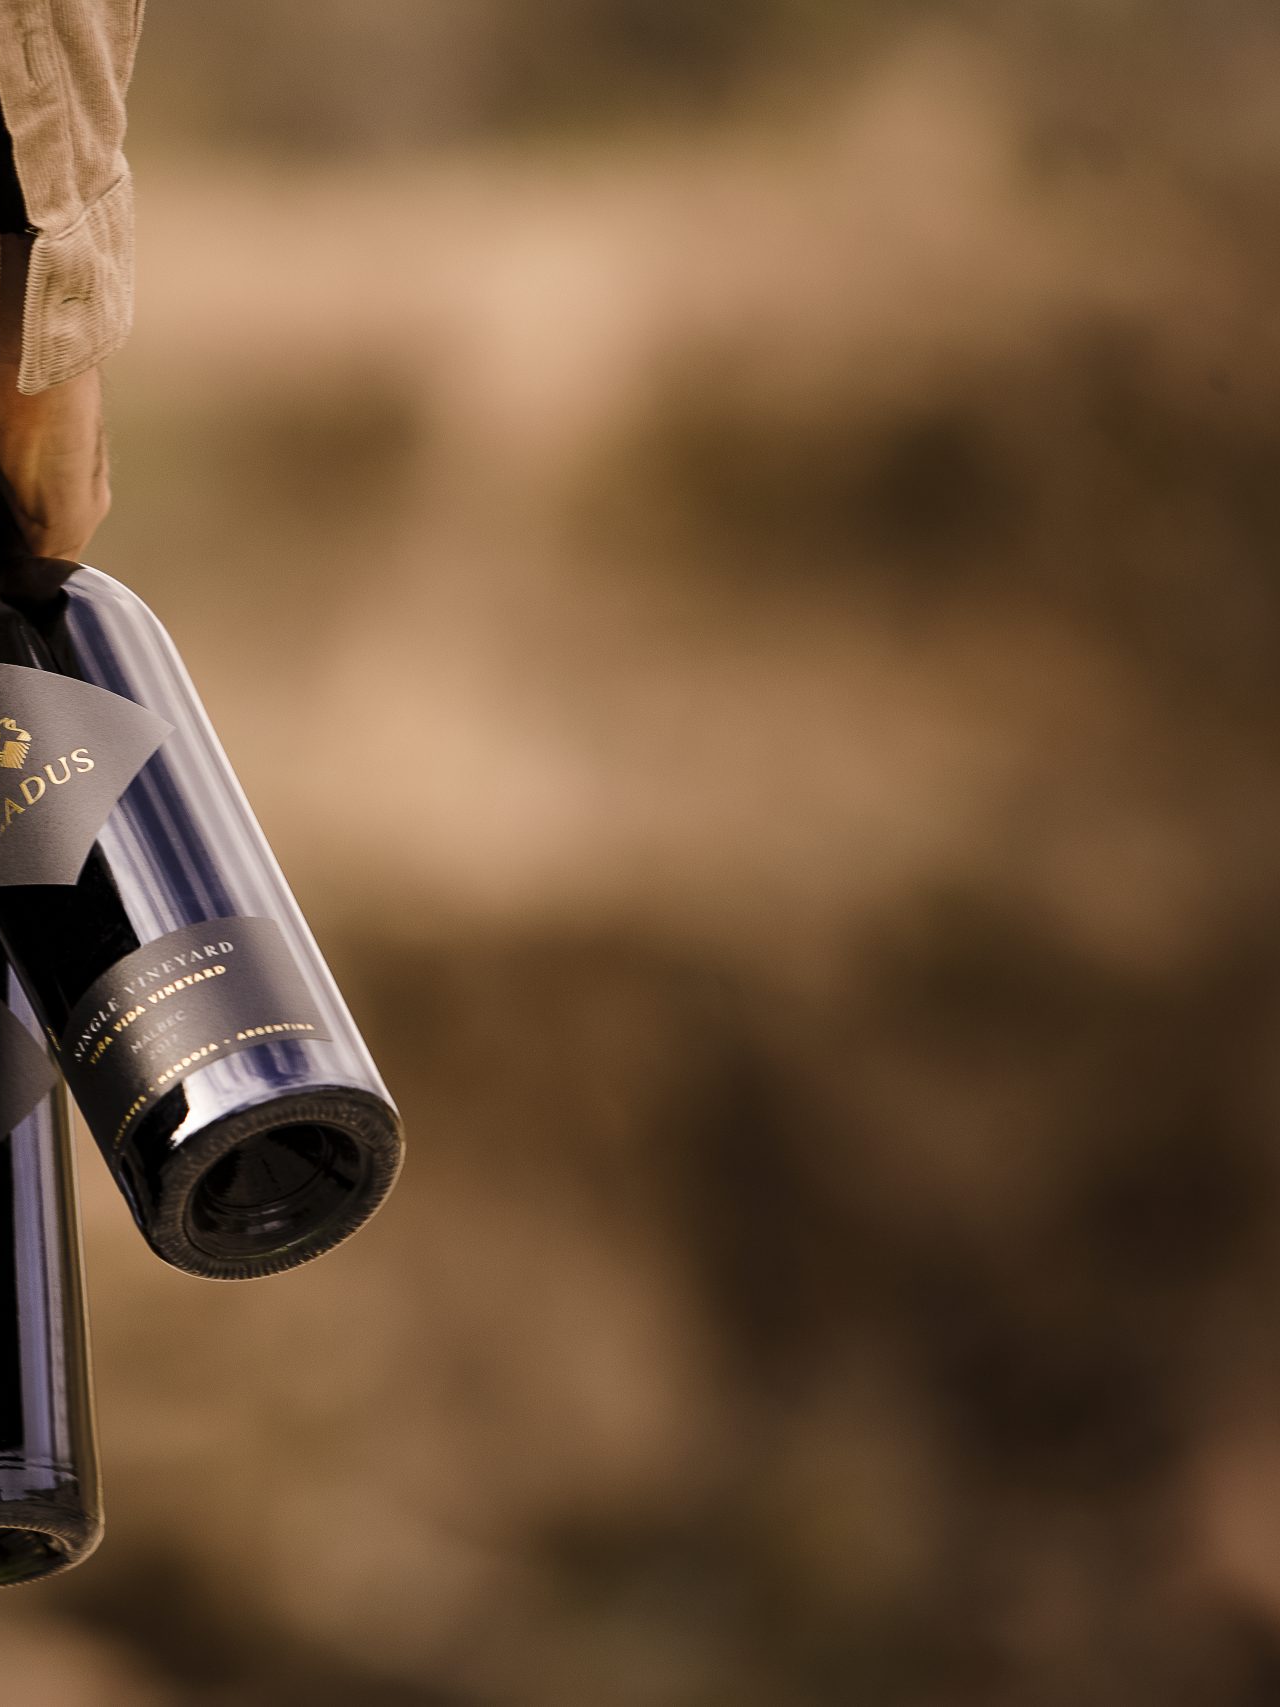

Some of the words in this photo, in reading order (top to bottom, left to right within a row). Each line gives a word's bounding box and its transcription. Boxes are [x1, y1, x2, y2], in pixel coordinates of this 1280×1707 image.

[75, 997, 120, 1062] SINGLE
[123, 941, 234, 995] VINEYARD
[113, 1005, 146, 1032] VIDA
[147, 965, 227, 1004] VINEYARD
[130, 1009, 188, 1055] MALBEC
[157, 1043, 219, 1084] MENDOZA
[236, 1022, 315, 1041] ARGENTINA
